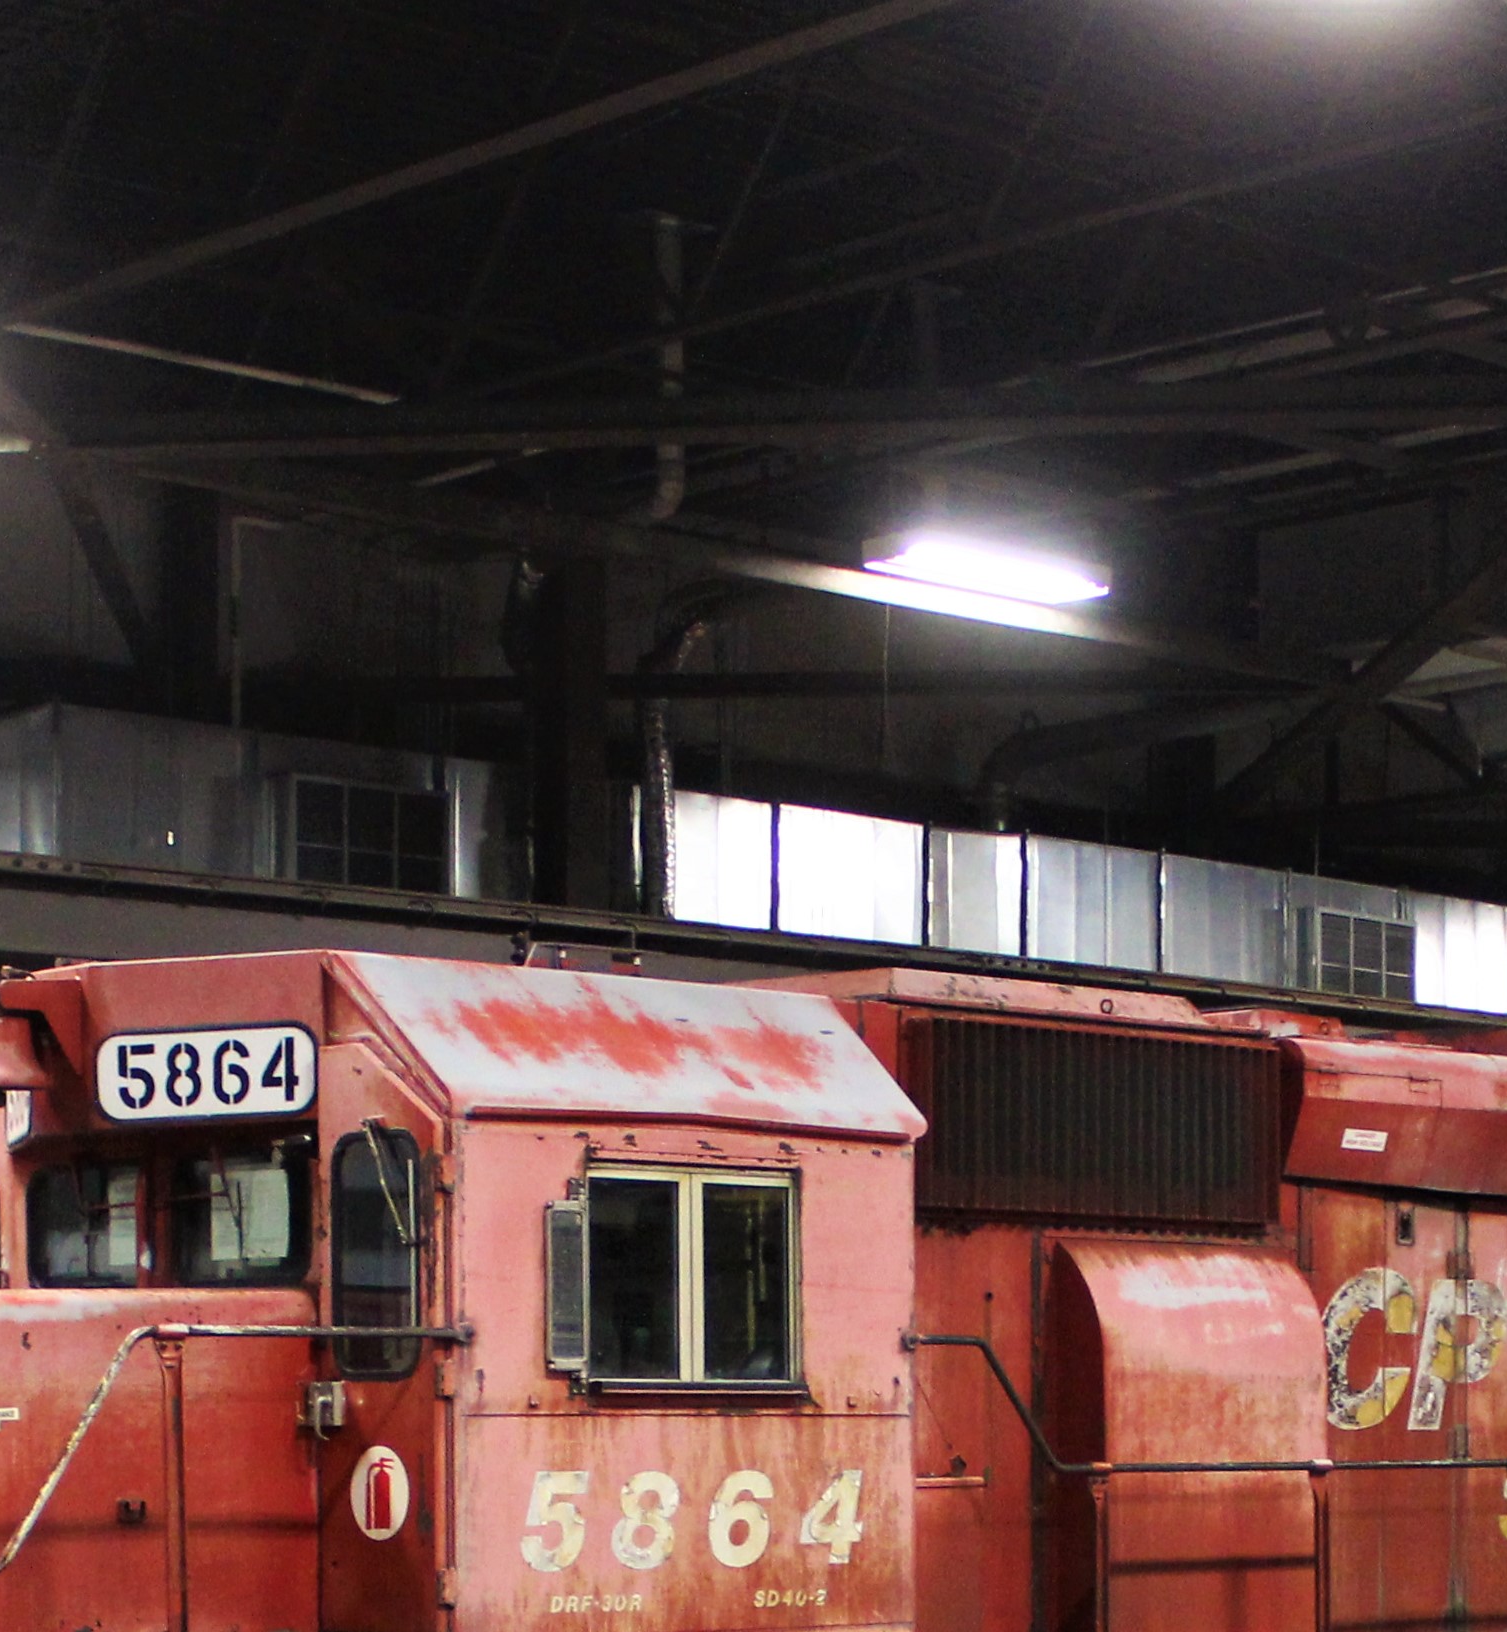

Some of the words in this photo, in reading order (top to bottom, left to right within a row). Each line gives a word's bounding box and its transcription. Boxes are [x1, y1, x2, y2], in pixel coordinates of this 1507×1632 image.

[116, 1035, 301, 1110] 5864
[1323, 1267, 1507, 1431] CP
[520, 1469, 864, 1572] 5864
[550, 1594, 643, 1614] DRF-30R
[753, 1588, 828, 1608] SD40-2
